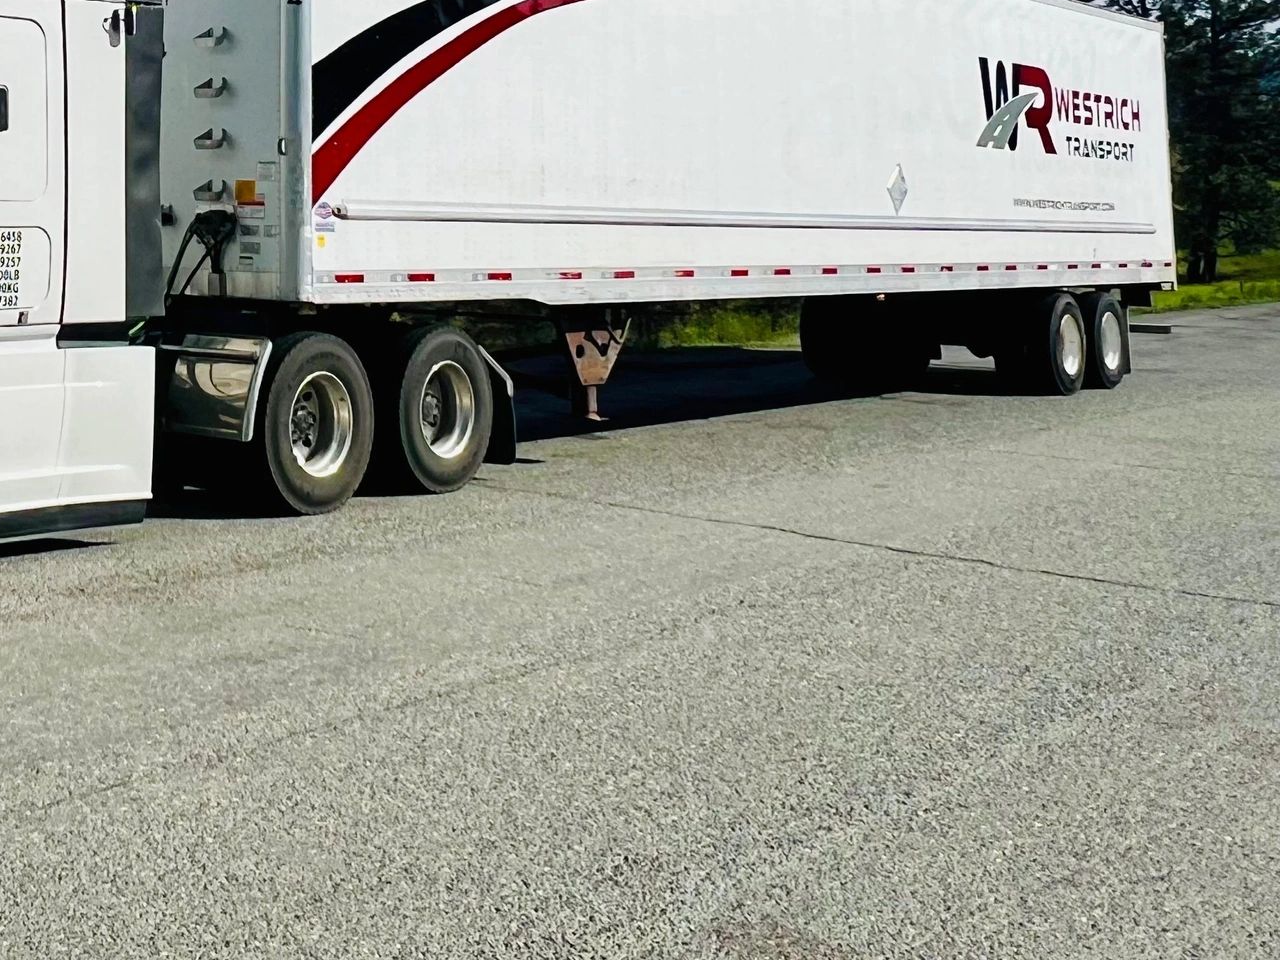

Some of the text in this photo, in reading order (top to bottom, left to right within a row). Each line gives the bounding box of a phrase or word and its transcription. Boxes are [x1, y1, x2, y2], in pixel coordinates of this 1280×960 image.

[977, 56, 1057, 155] WR
[1055, 87, 1141, 131] WESTRICH
[1066, 136, 1134, 161] TRANSPORT
